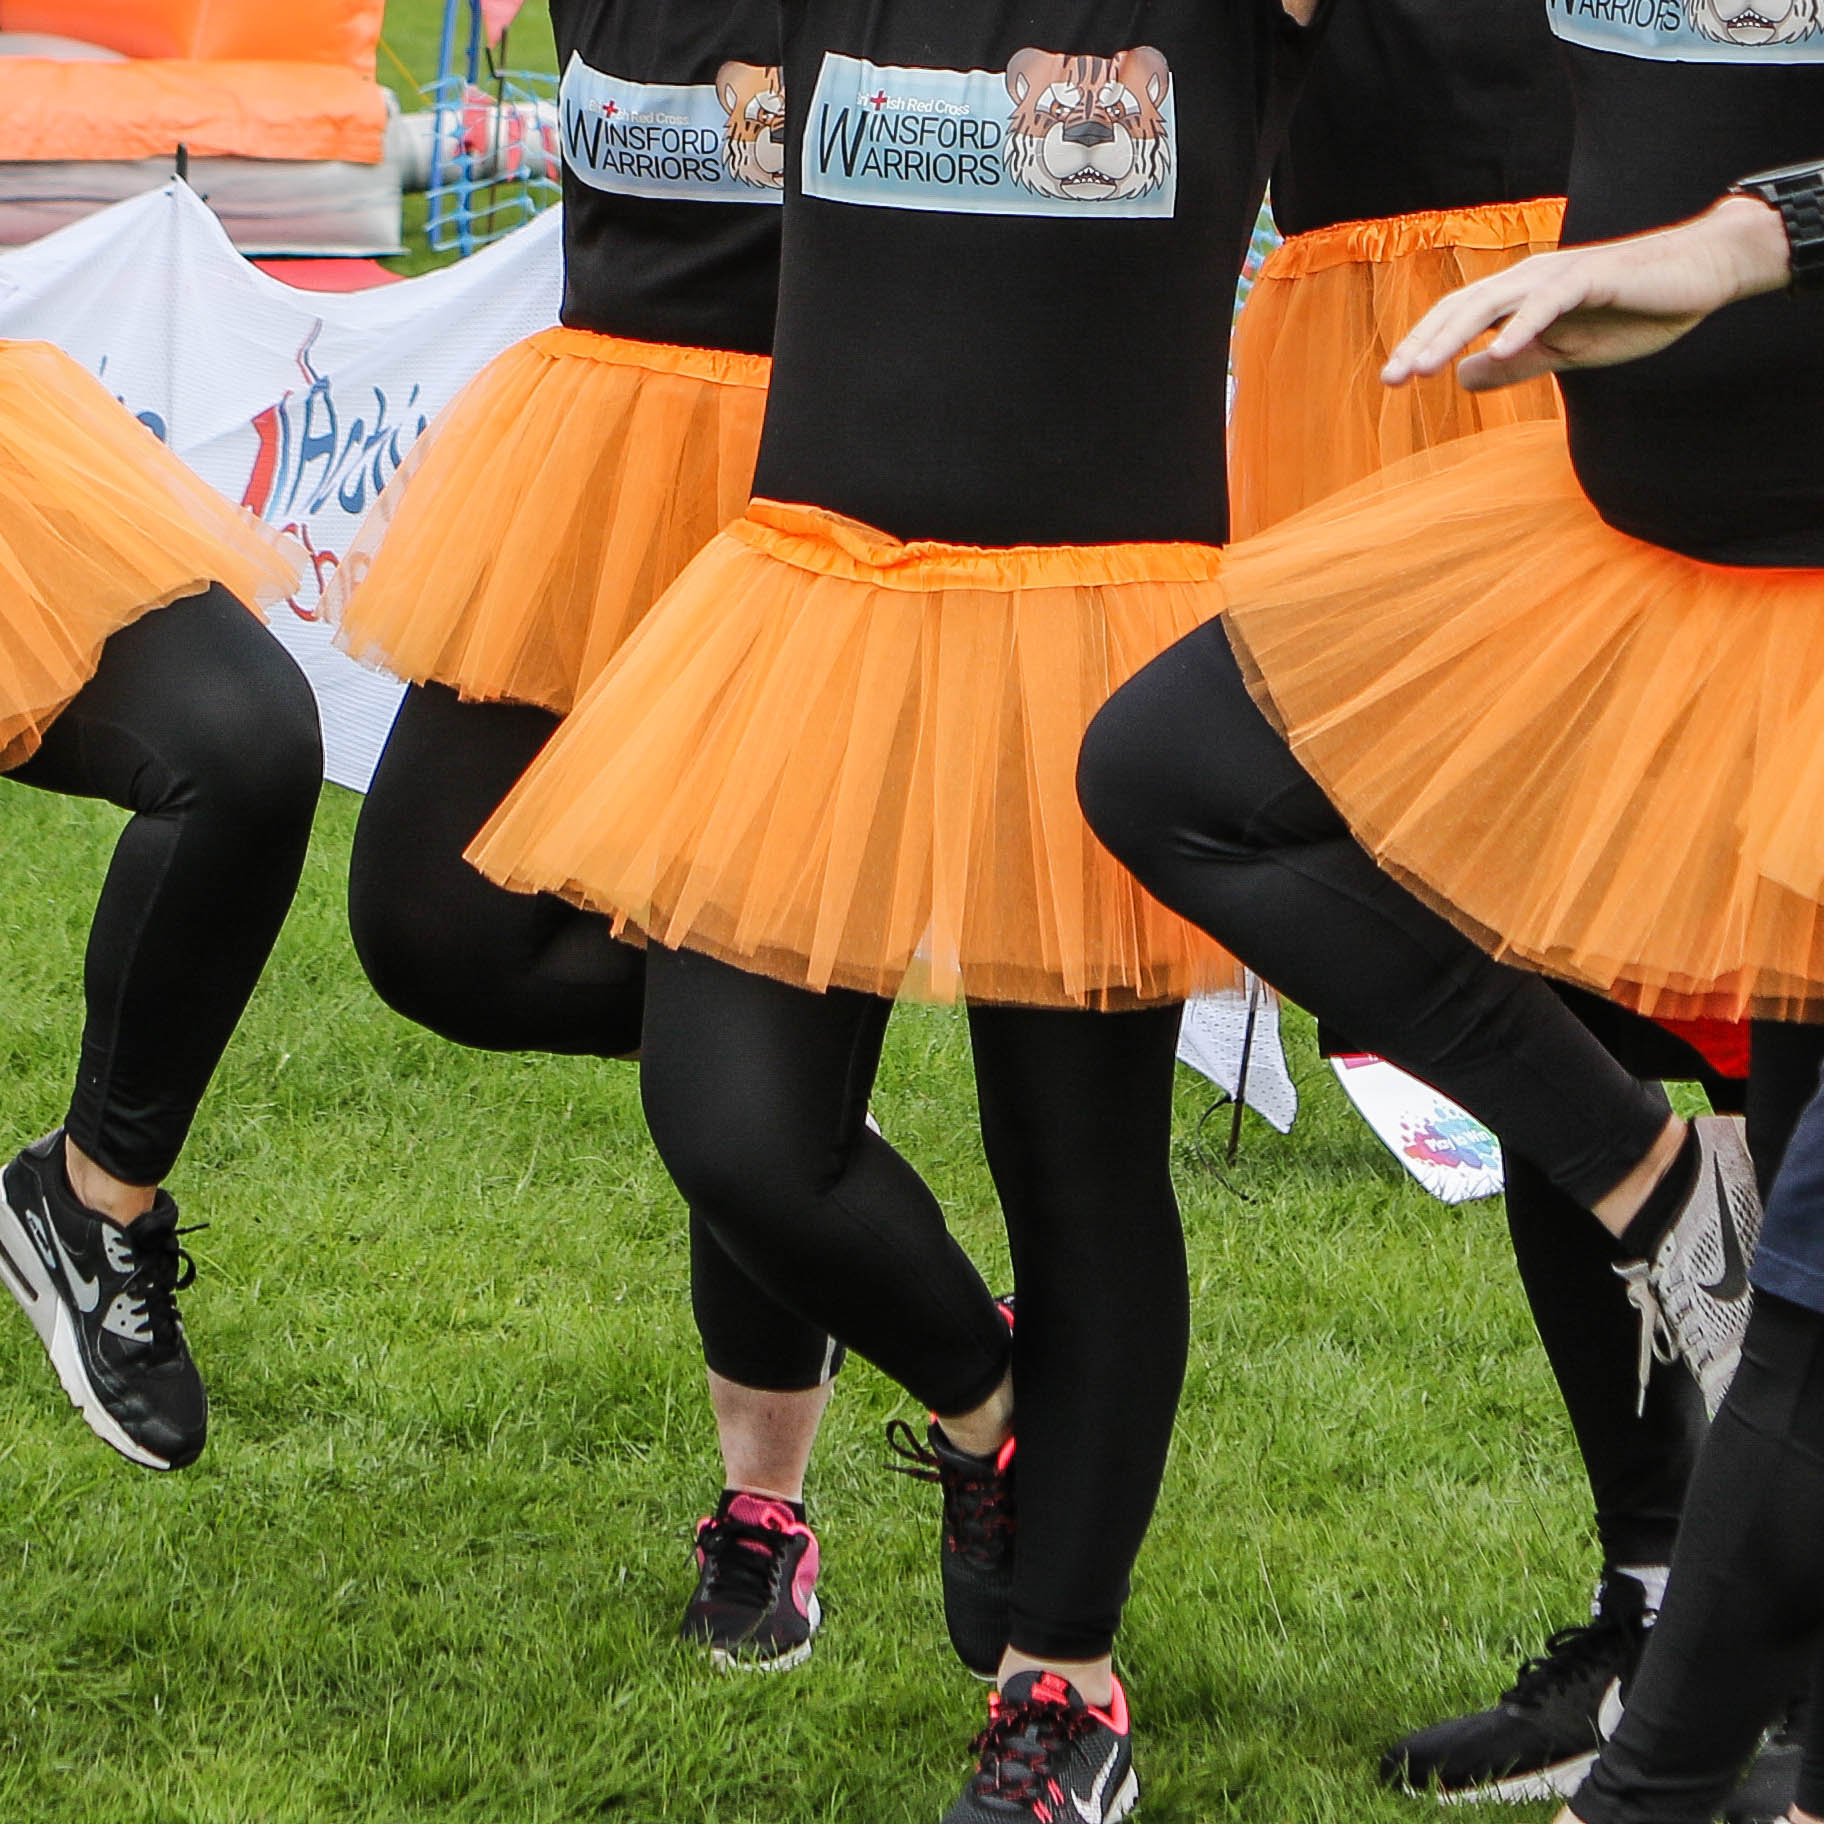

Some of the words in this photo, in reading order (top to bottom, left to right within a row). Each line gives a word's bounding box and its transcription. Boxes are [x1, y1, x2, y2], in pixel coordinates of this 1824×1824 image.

[567, 99, 719, 169] WINSFORD
[819, 103, 1002, 177] WINSFORD
[906, 98, 933, 114] Red
[934, 99, 971, 117] Cross
